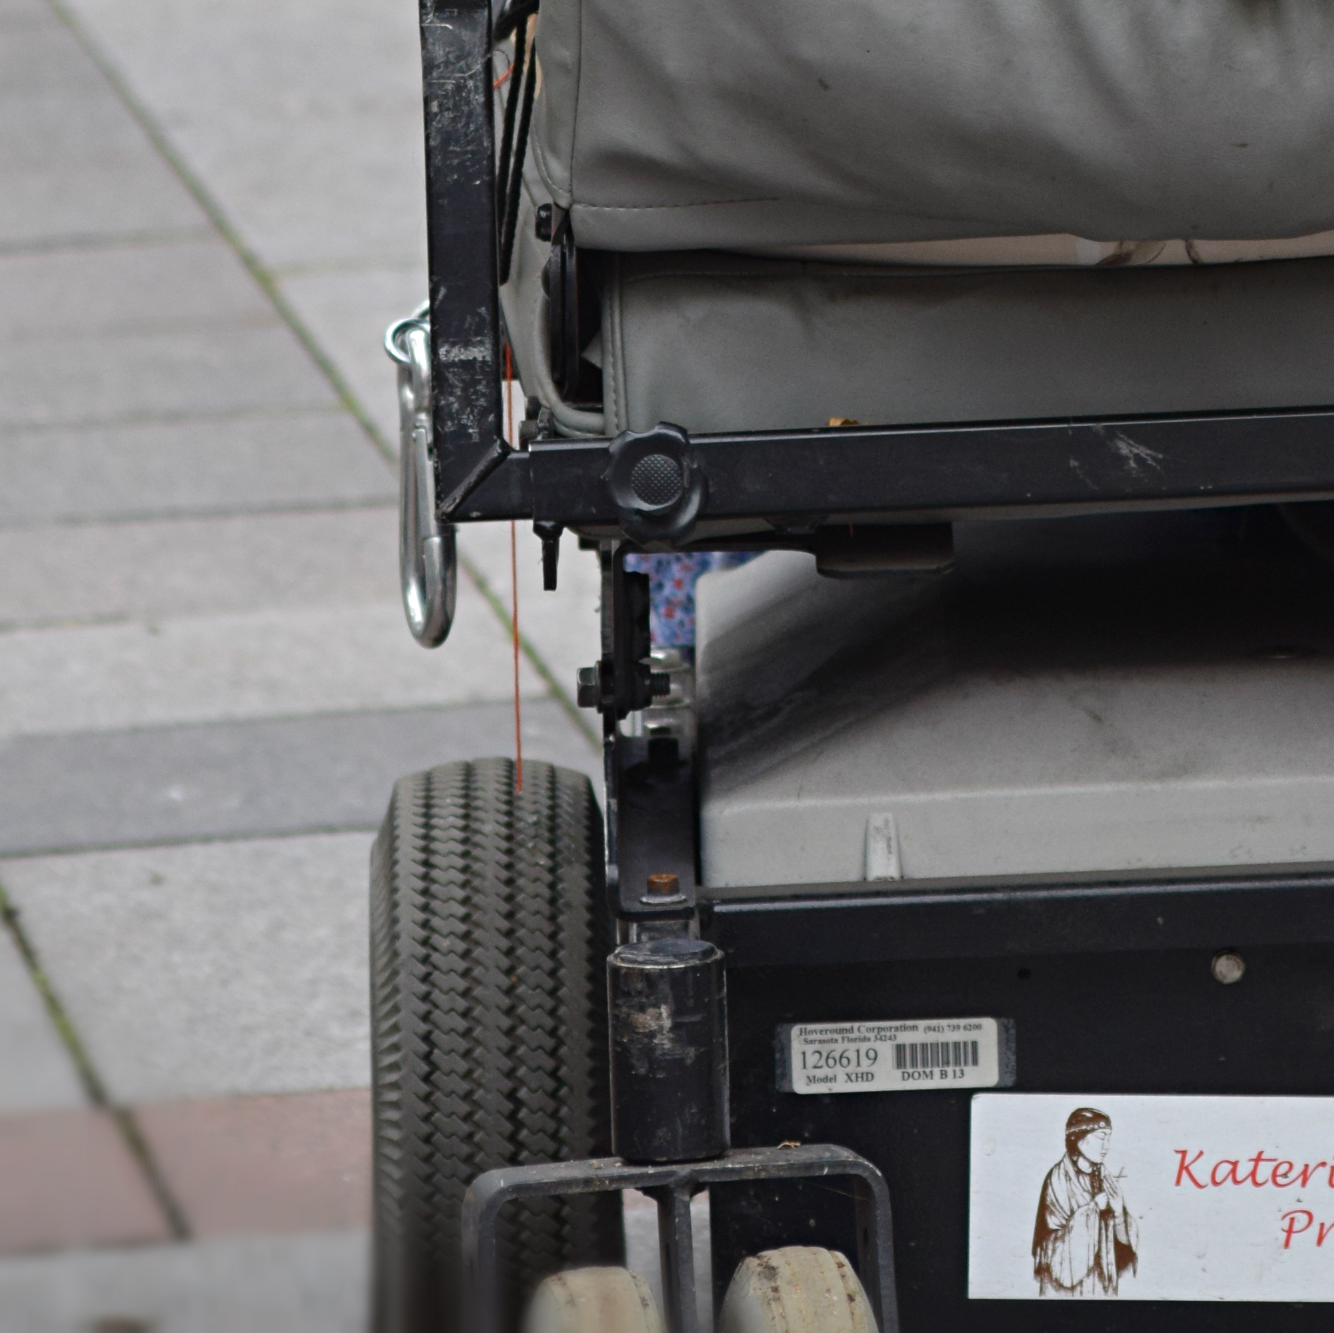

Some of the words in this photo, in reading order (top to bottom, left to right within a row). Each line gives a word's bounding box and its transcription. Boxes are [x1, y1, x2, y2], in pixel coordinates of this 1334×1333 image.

[799, 1026, 854, 1036] Hoveround
[858, 1023, 918, 1034] Corporation
[803, 1037, 838, 1045] Sarasota
[841, 1035, 871, 1044] Florida
[801, 1048, 878, 1070] 126619
[806, 1075, 837, 1085] Model
[845, 1073, 874, 1083] XHD
[901, 1070, 934, 1081] DOM
[940, 1070, 948, 1079] B
[952, 1069, 965, 1079] 13
